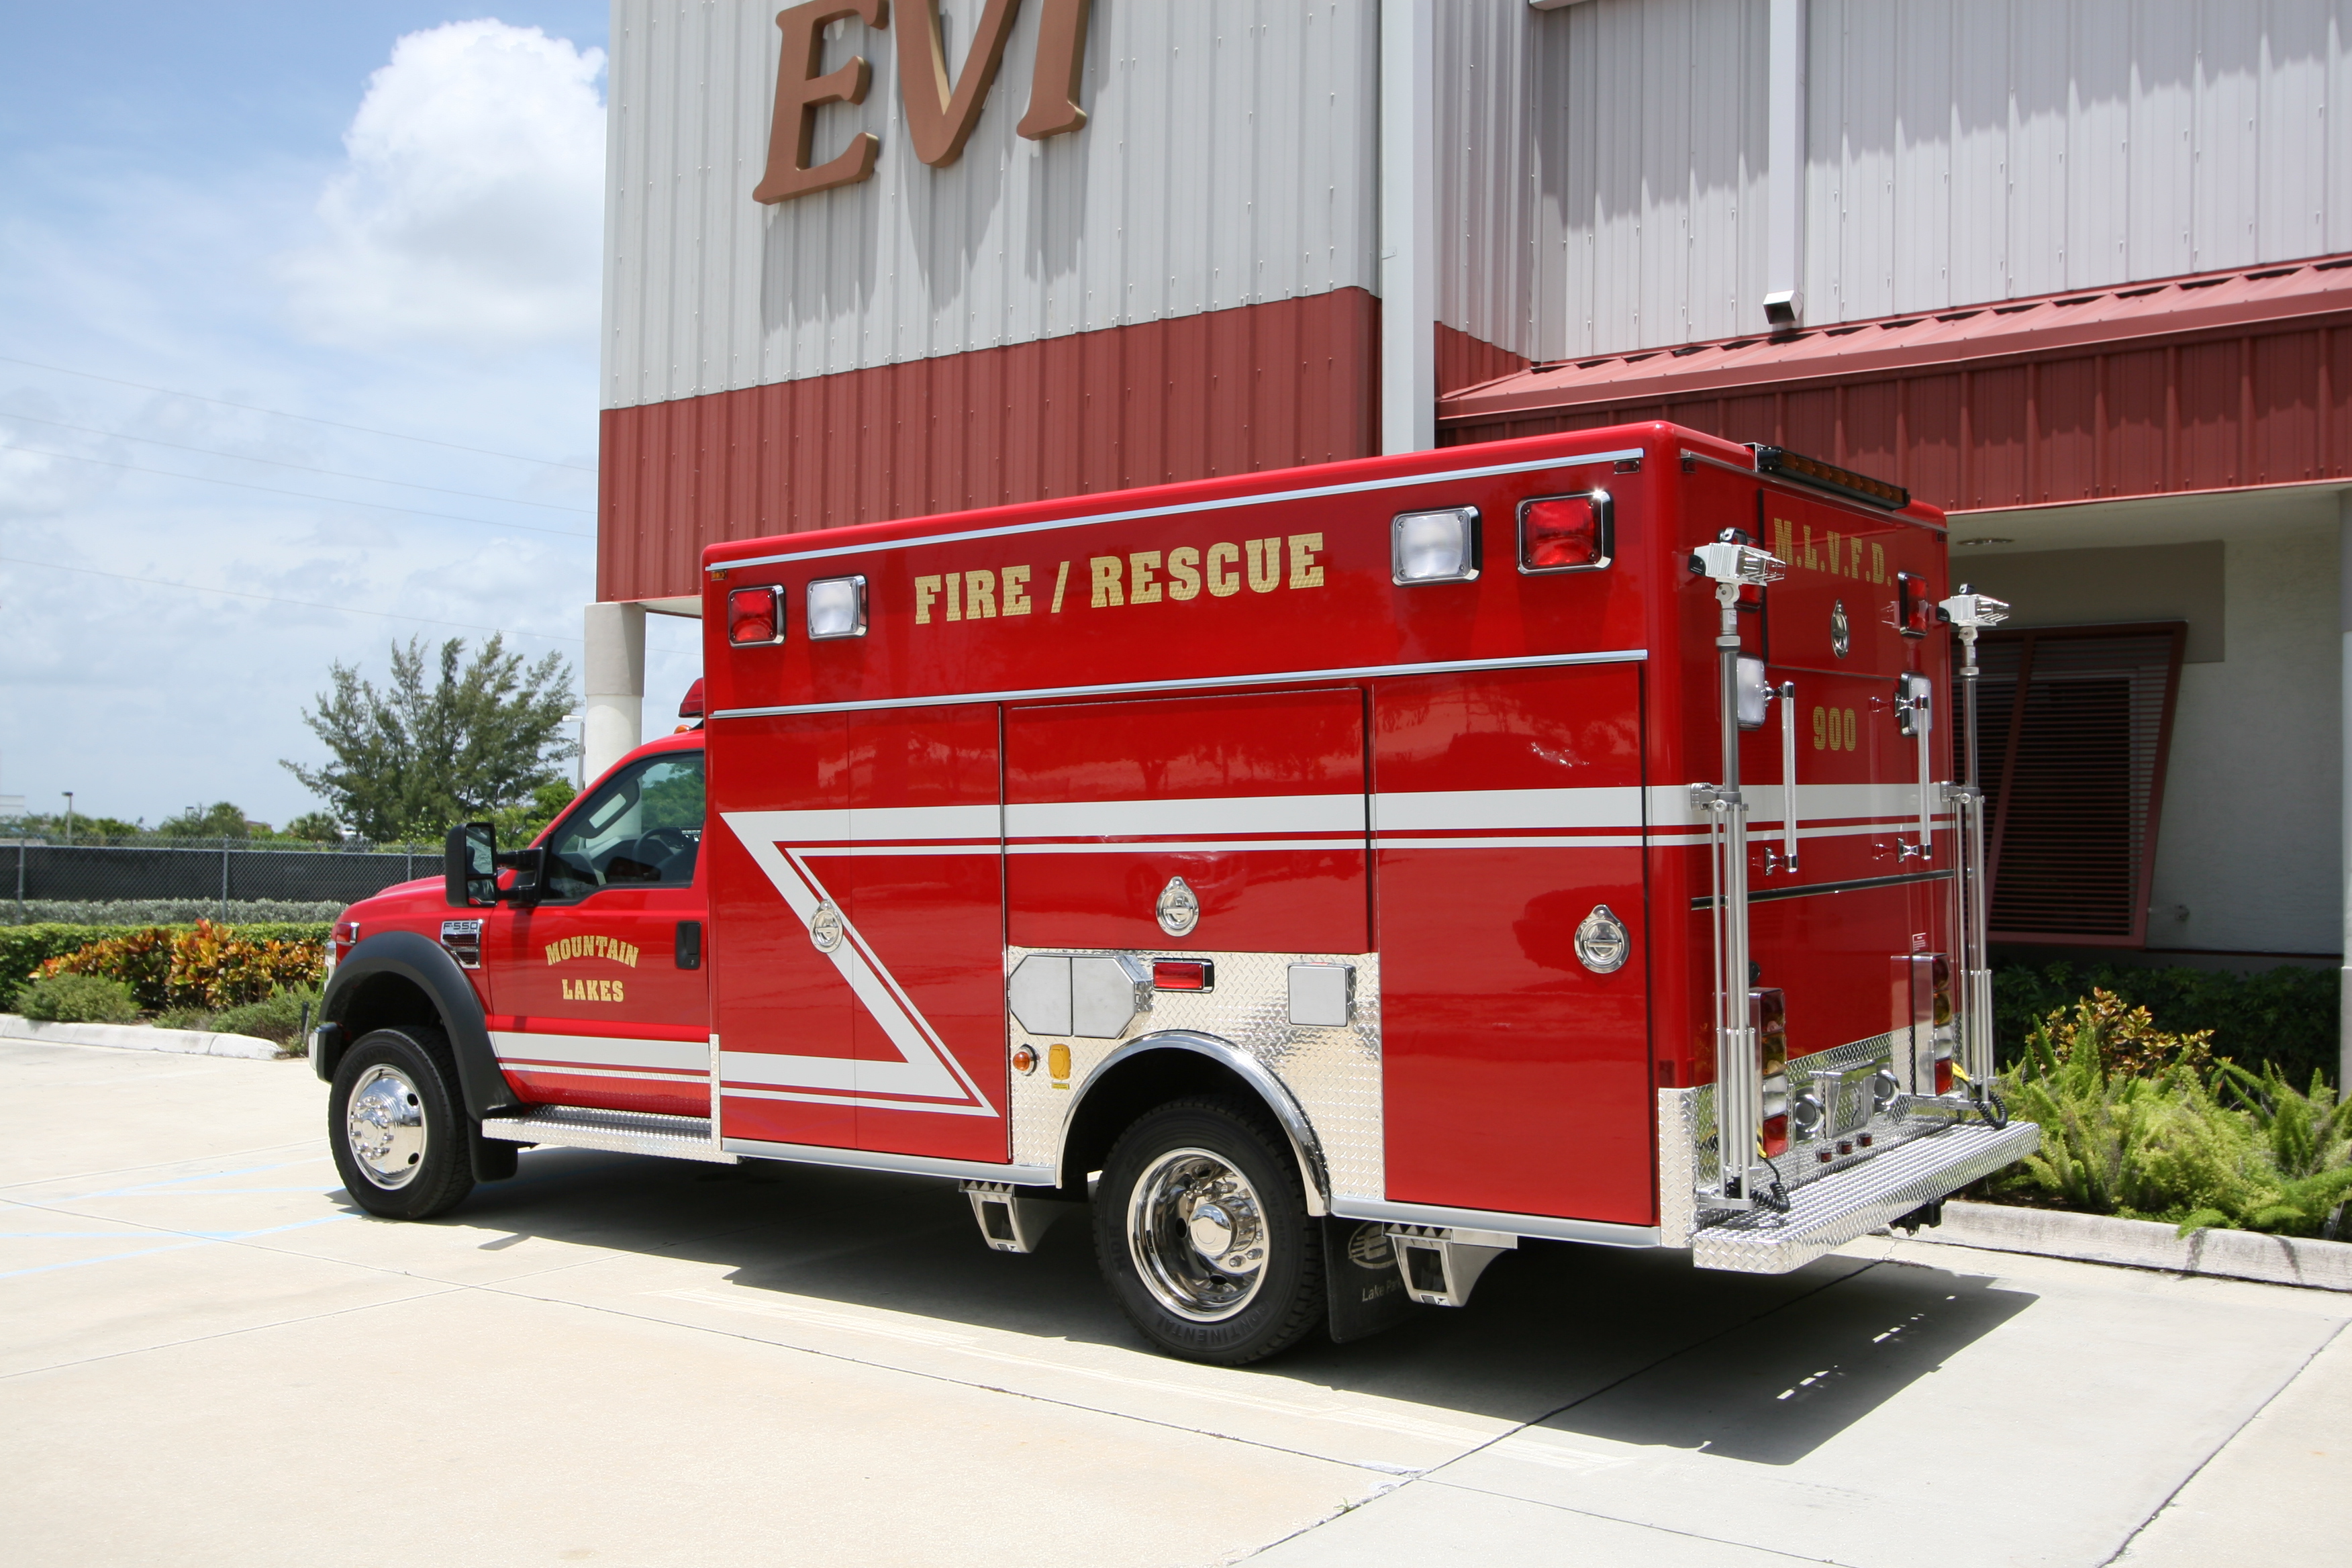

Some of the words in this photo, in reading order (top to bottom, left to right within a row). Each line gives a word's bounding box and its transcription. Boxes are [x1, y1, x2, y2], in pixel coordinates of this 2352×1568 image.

[752, 0, 1091, 205] EVI
[914, 565, 1031, 625] FIRE
[1090, 532, 1324, 608] RESCUE
[1813, 706, 1856, 751] 900
[443, 922, 478, 930] F-550
[545, 935, 639, 968] MOUNTAIN
[561, 979, 625, 1003] LAKES
[1362, 1285, 1385, 1302] Lake
[1156, 1302, 1271, 1344] CONTINENTAL
